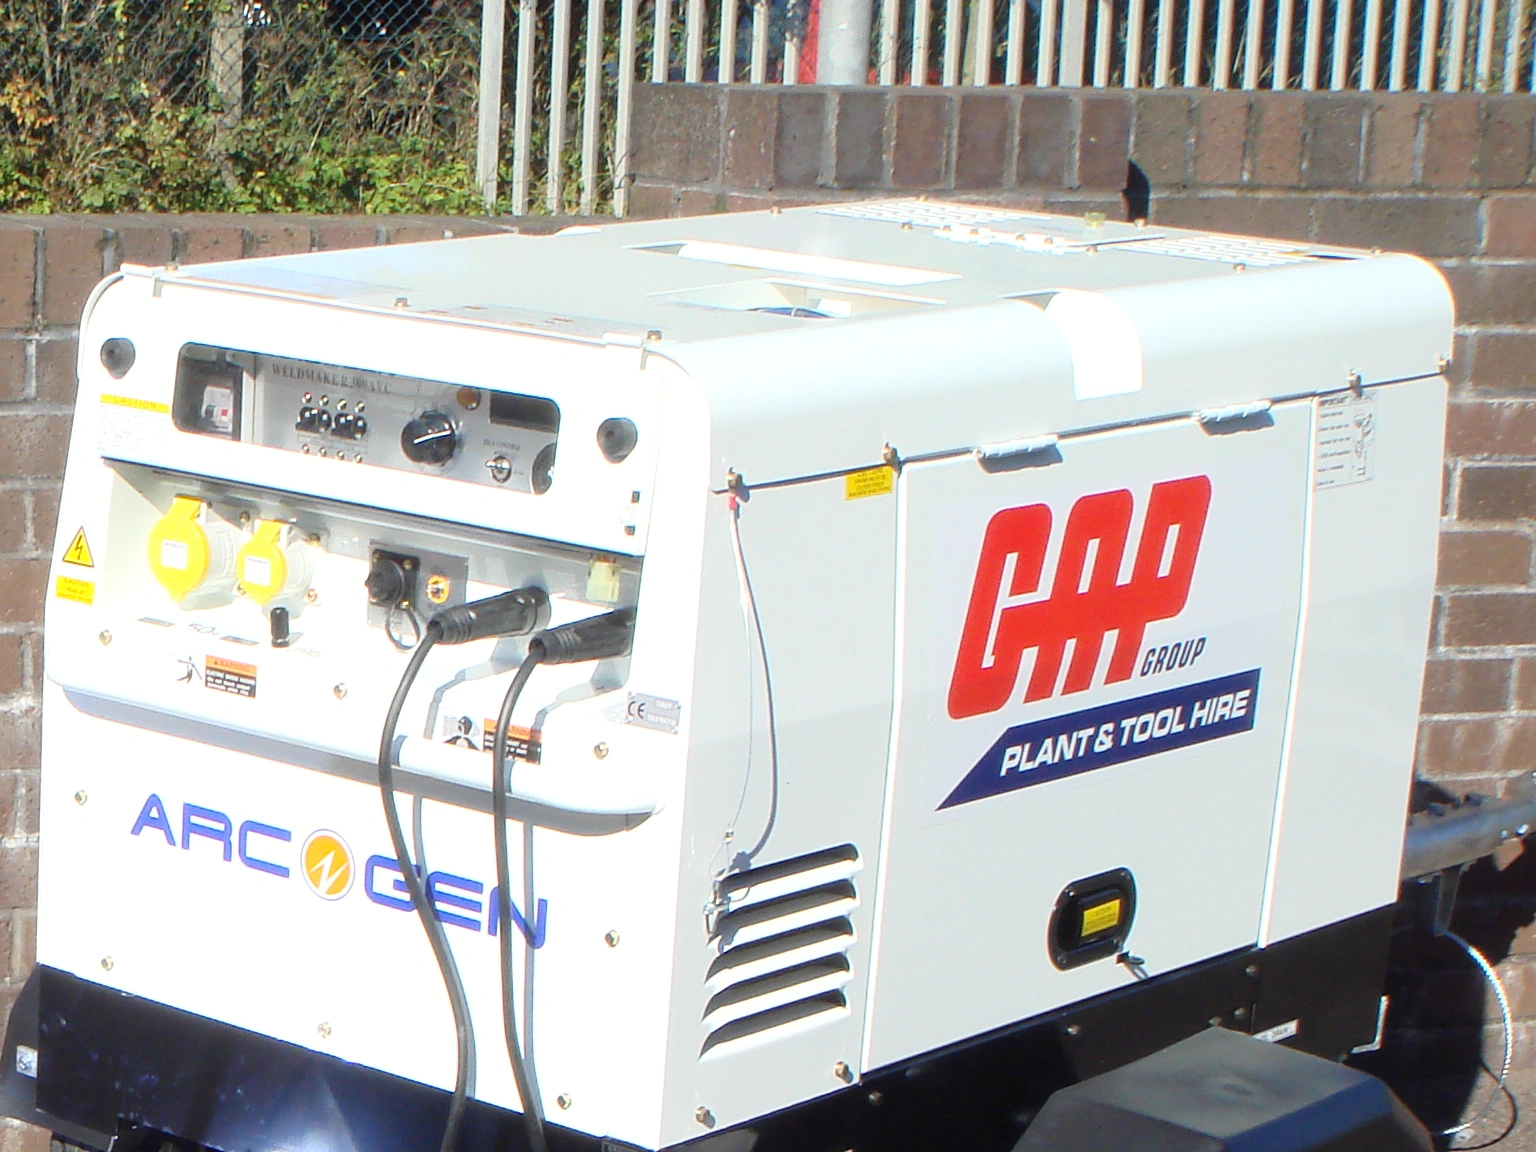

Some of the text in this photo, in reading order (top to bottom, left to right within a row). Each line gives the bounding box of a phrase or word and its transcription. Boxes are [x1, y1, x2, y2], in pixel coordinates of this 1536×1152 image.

[113, 395, 157, 410] CAUTION
[947, 474, 1212, 720] GAP
[1139, 636, 1208, 678] GROUP
[999, 688, 1253, 778] PLANT & TOOL HIRE
[130, 793, 548, 950] ARC GEN
